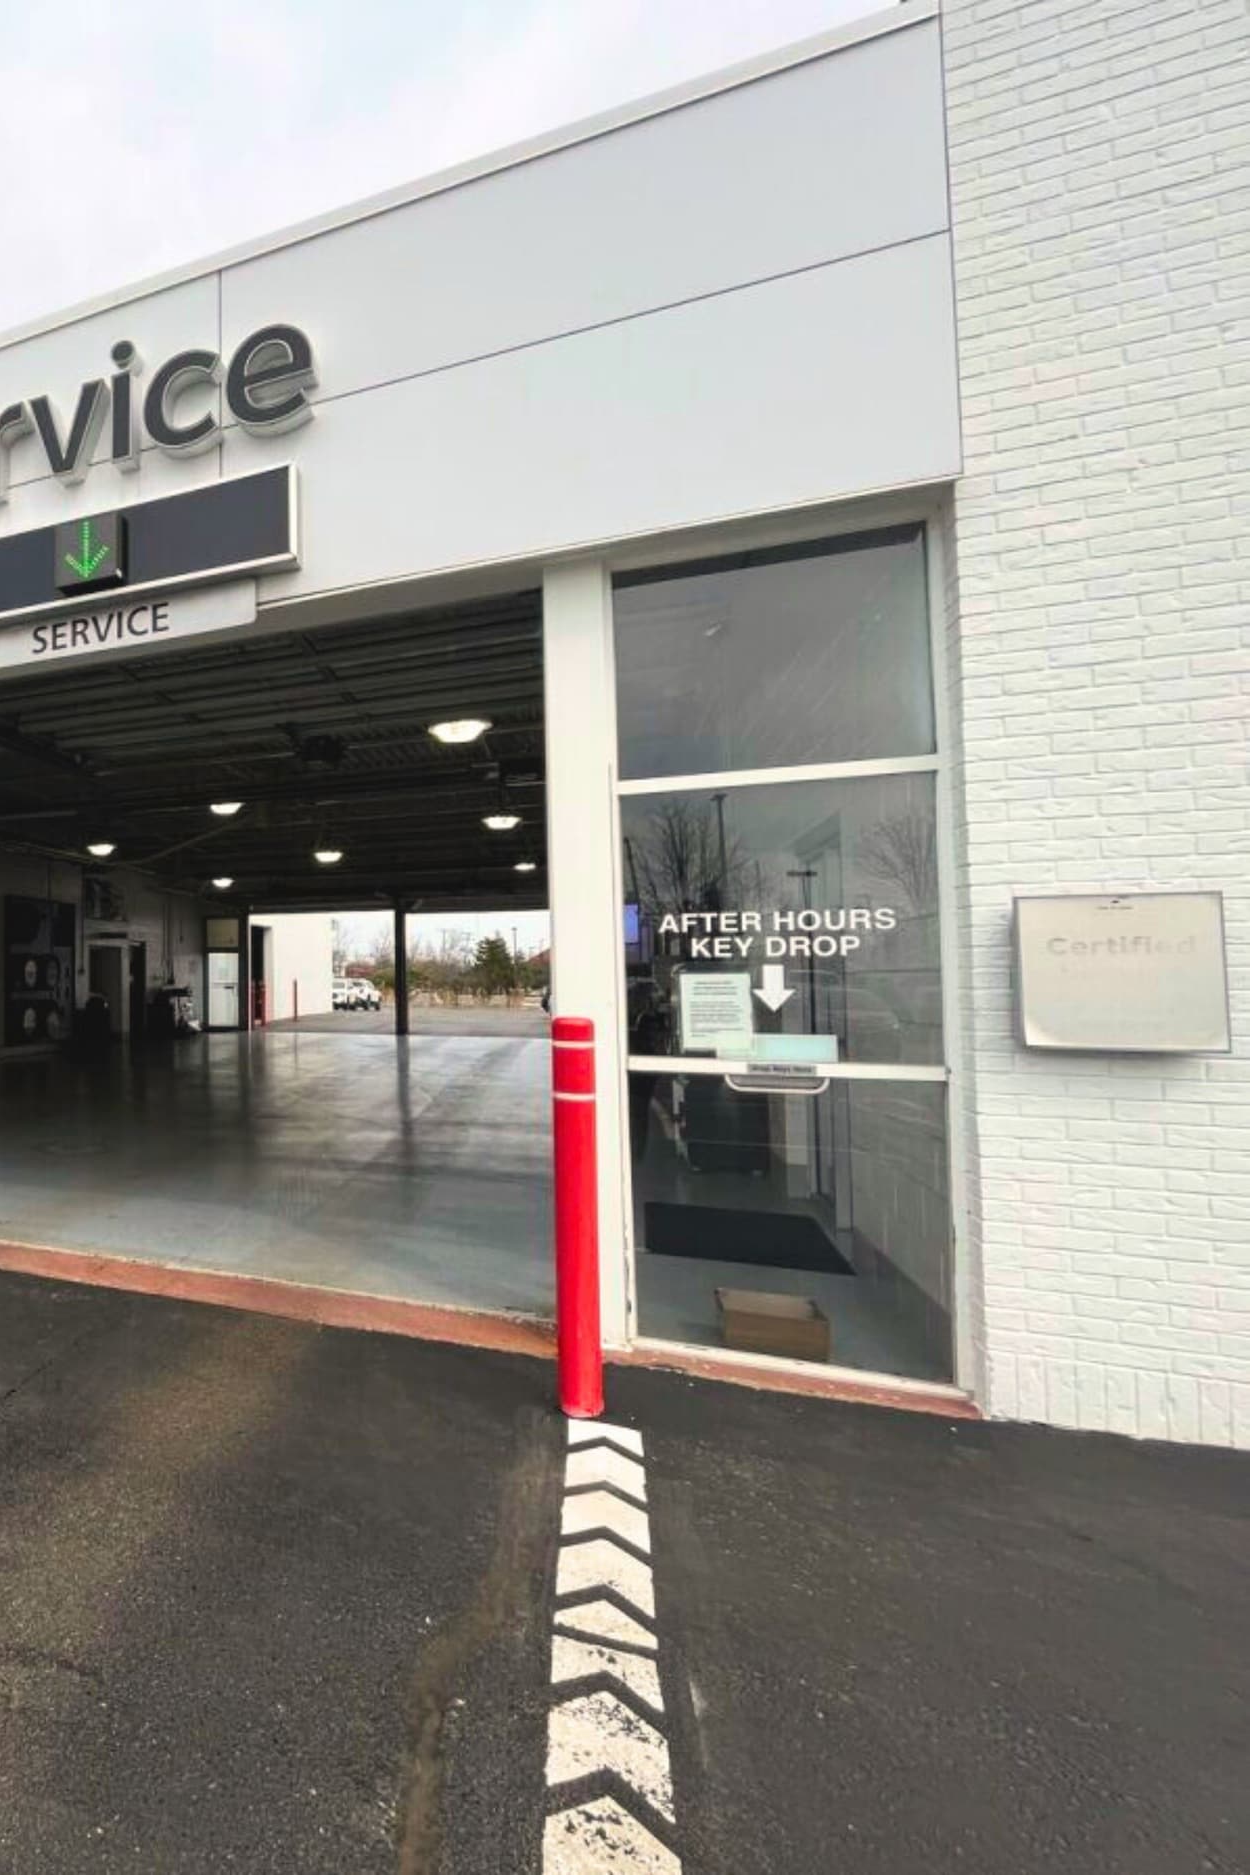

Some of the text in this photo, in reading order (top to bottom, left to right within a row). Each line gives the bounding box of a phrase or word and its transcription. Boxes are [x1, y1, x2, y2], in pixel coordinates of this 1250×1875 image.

[31, 602, 170, 653] SERVICE
[658, 908, 897, 933] AFTER HOURS
[690, 936, 860, 958] KEY DROP
[1046, 935, 1196, 957] Certified
